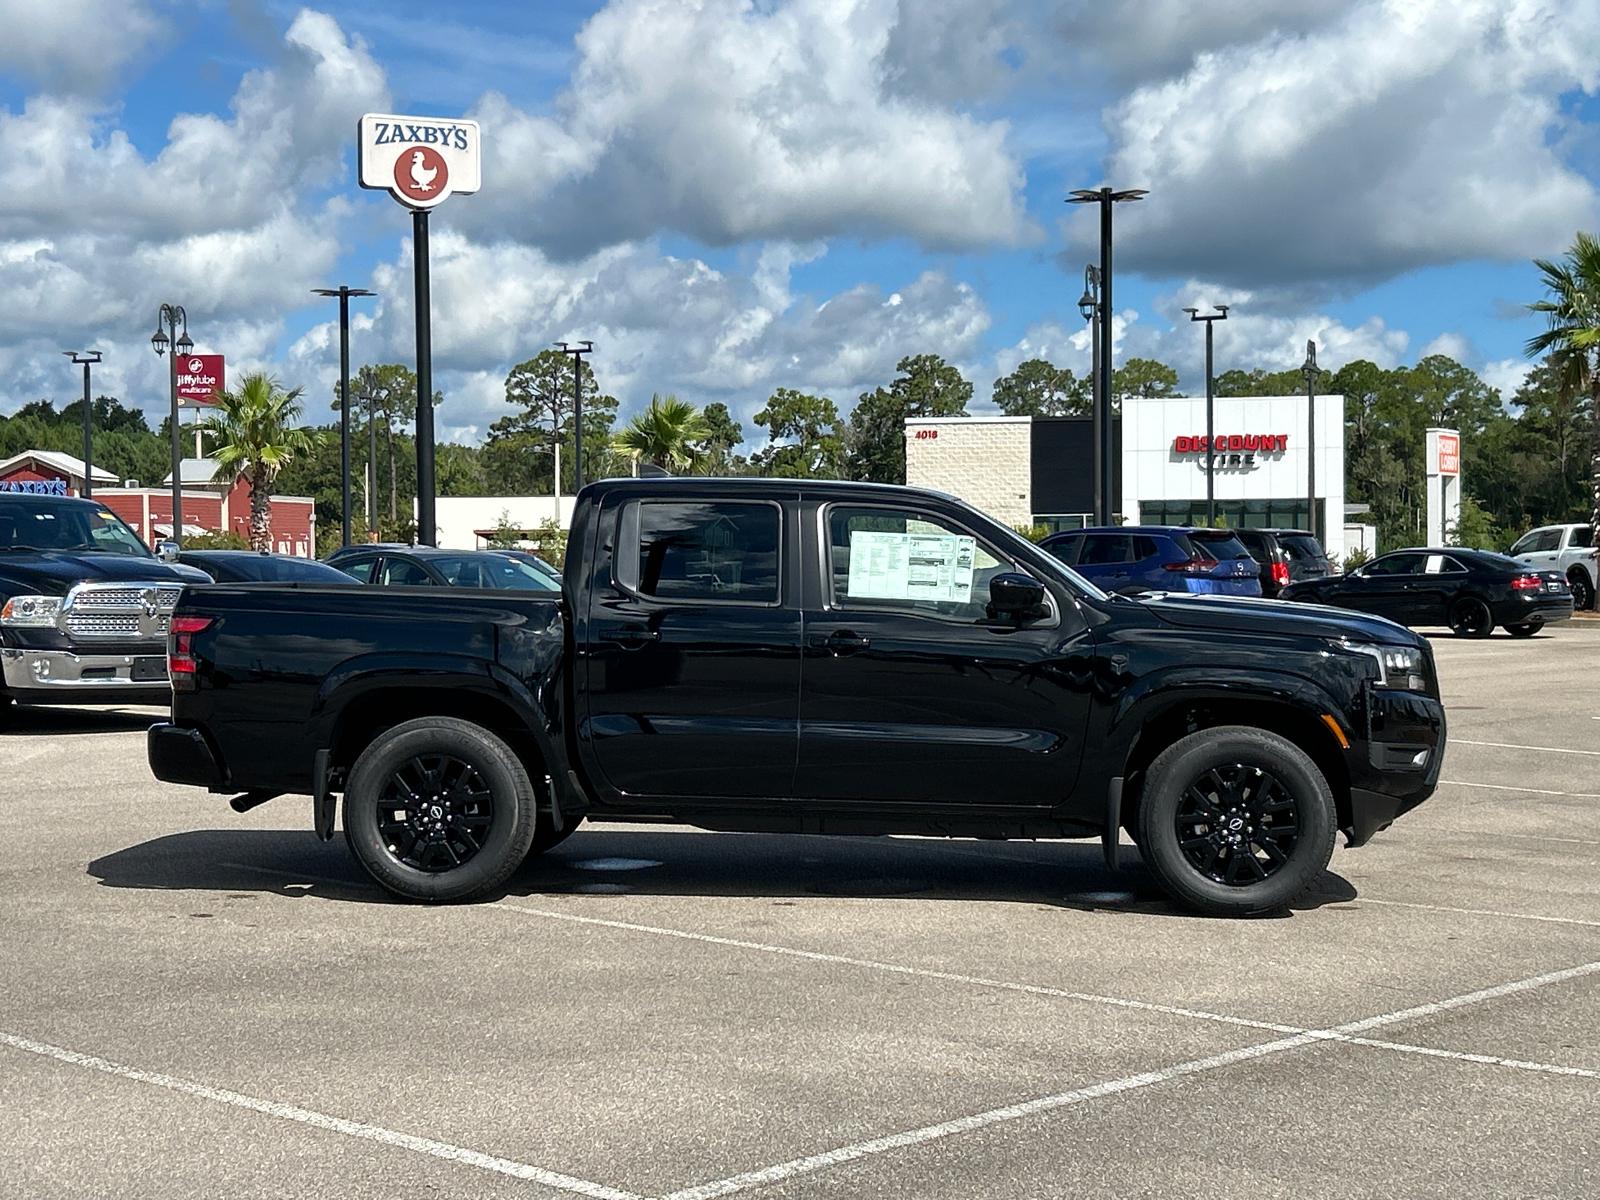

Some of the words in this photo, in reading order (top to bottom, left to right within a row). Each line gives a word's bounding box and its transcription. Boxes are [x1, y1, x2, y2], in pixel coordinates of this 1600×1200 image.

[375, 123, 468, 150] ZAXBY'S
[915, 430, 938, 440] 4018
[1175, 434, 1288, 452] DISCOUNT
